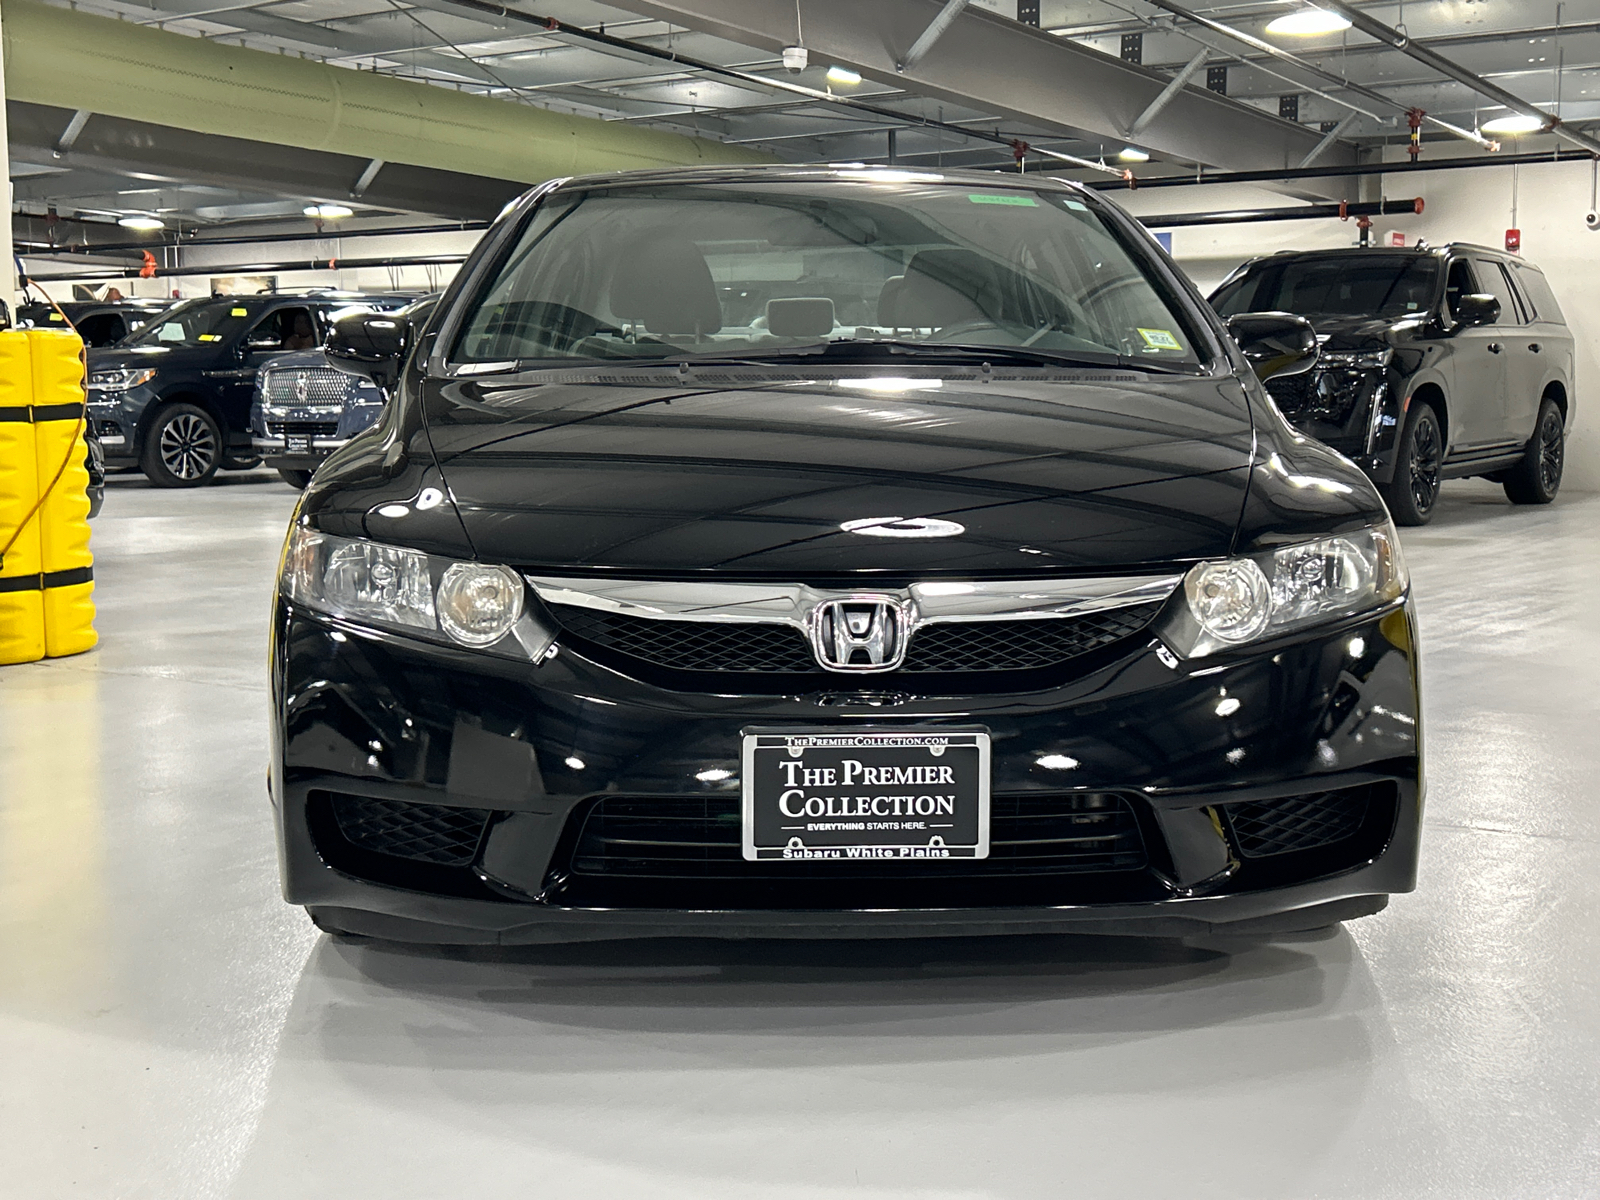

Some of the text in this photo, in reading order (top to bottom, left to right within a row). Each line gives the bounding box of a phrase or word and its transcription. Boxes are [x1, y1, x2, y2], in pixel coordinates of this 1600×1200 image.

[779, 759, 955, 787] THE PREMIER
[778, 789, 955, 818] COLLECTION
[807, 821, 927, 831] EVERYTHING STARTS HERE.
[782, 847, 950, 858] Subaru White Plains
